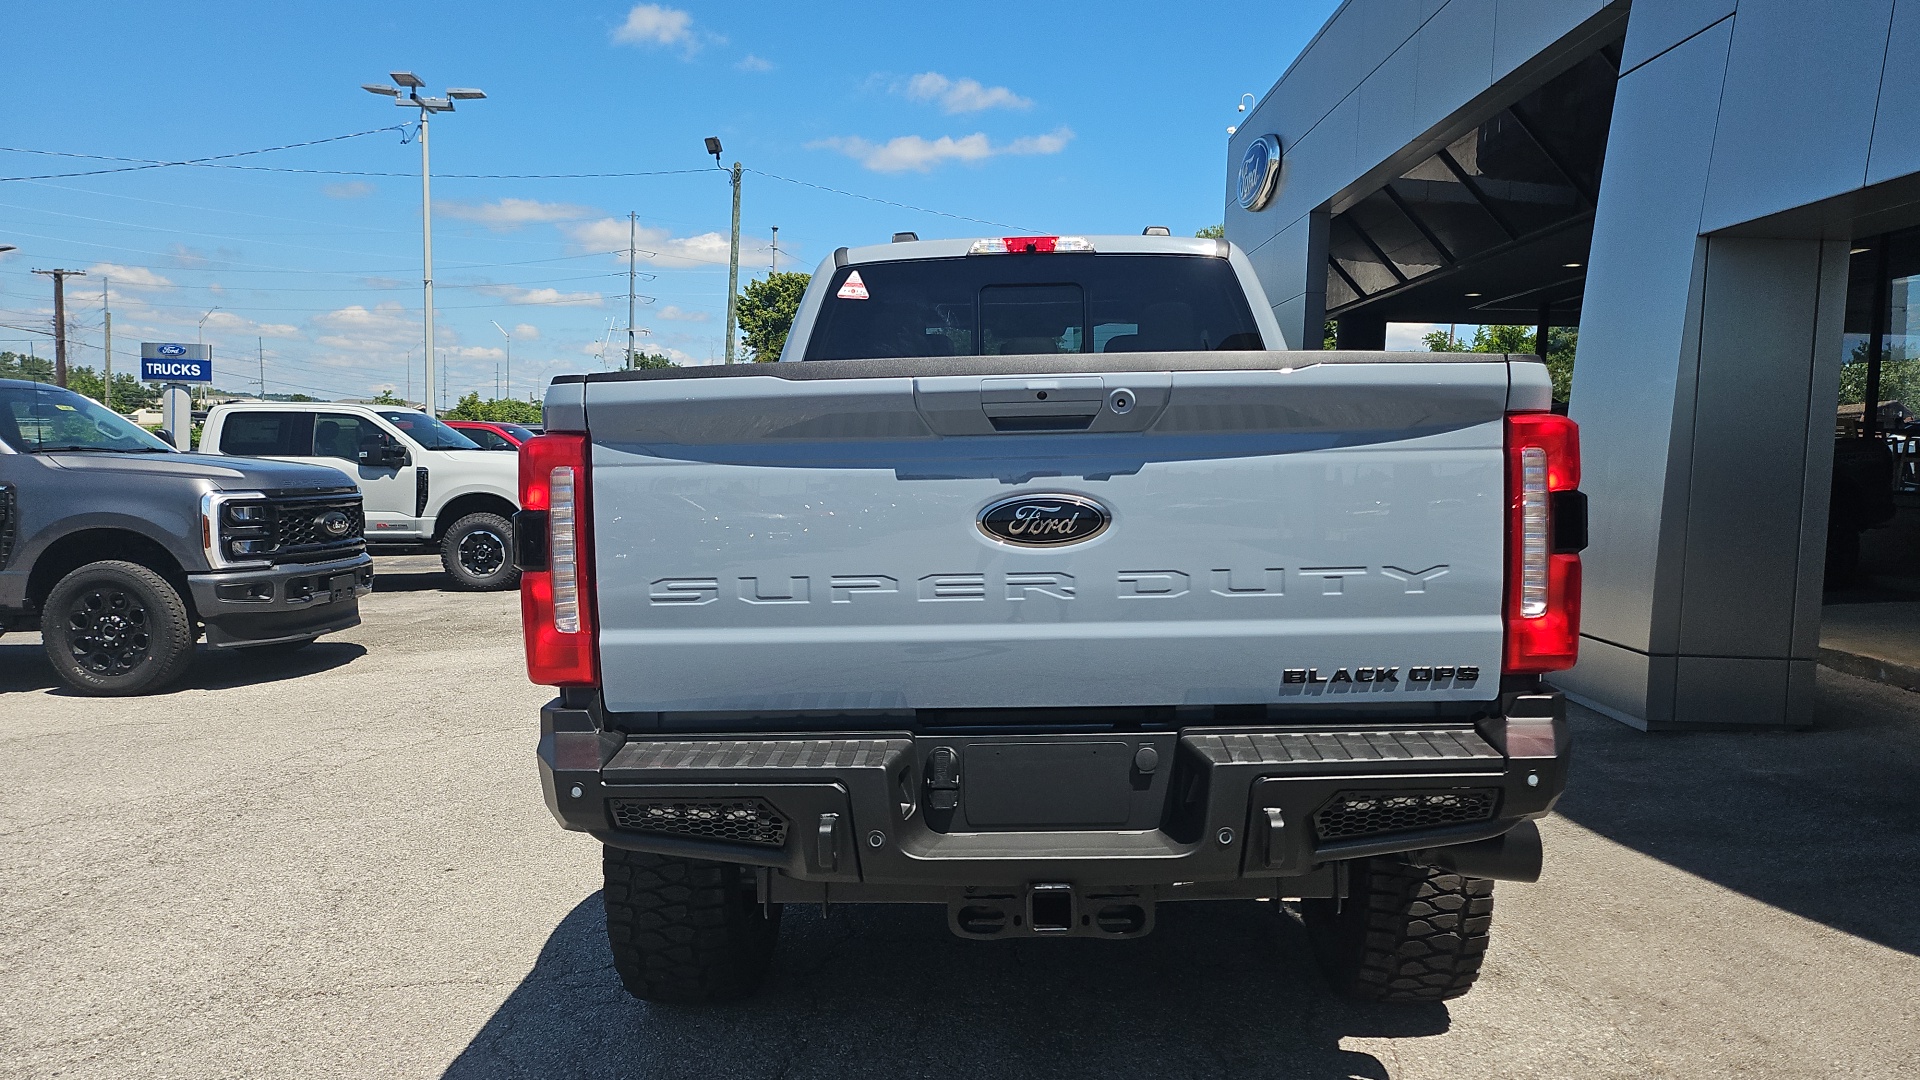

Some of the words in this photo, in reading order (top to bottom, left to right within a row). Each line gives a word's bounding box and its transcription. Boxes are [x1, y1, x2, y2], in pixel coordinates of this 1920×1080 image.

[1240, 154, 1260, 200] Ford
[162, 346, 180, 354] Ford
[146, 363, 201, 376] TRUCKS
[1008, 505, 1080, 535] Ford
[650, 571, 1076, 606] SUPER
[1117, 564, 1449, 599] DUTY
[1283, 667, 1399, 684] BLACK
[1409, 665, 1480, 682] OPS
